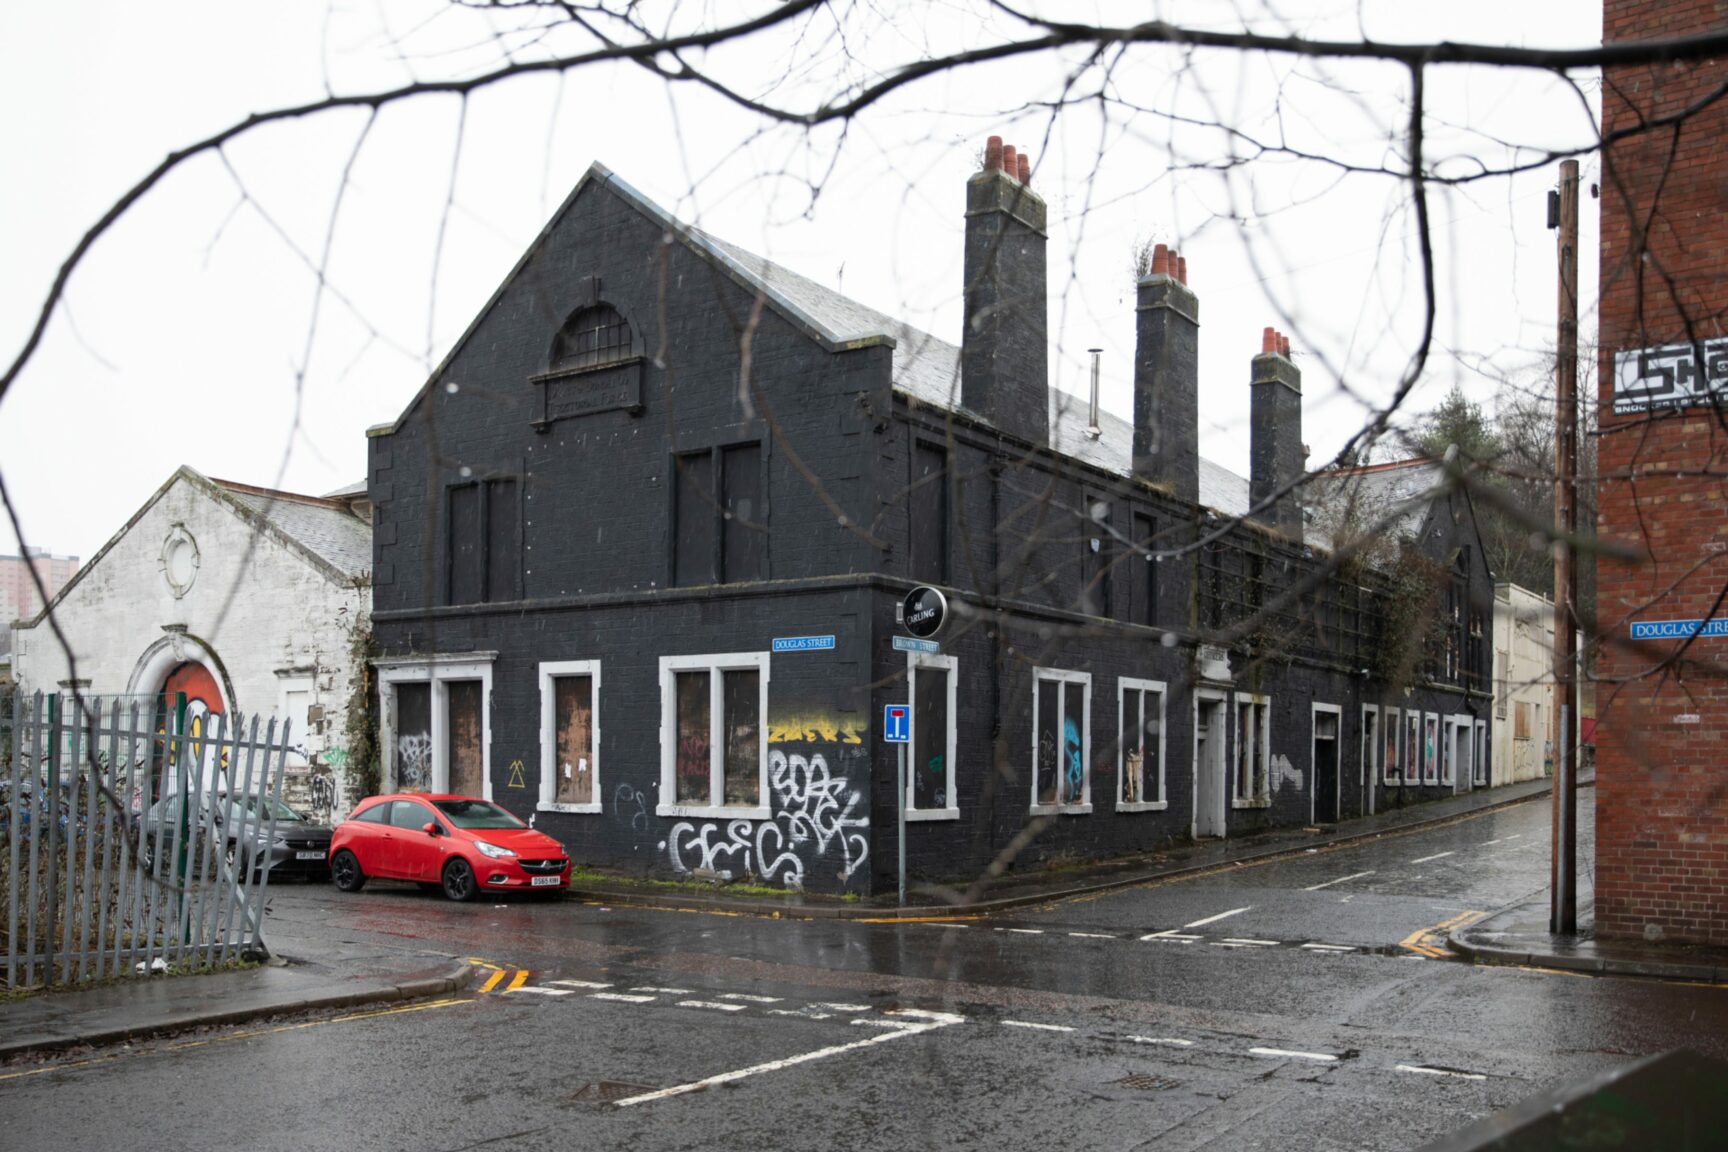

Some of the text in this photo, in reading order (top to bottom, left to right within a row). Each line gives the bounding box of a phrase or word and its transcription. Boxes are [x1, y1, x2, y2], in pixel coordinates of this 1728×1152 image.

[907, 608, 935, 625] CARLING
[1636, 622, 1695, 637] DOUGLAS
[775, 638, 832, 650] DOUGLAS STREET
